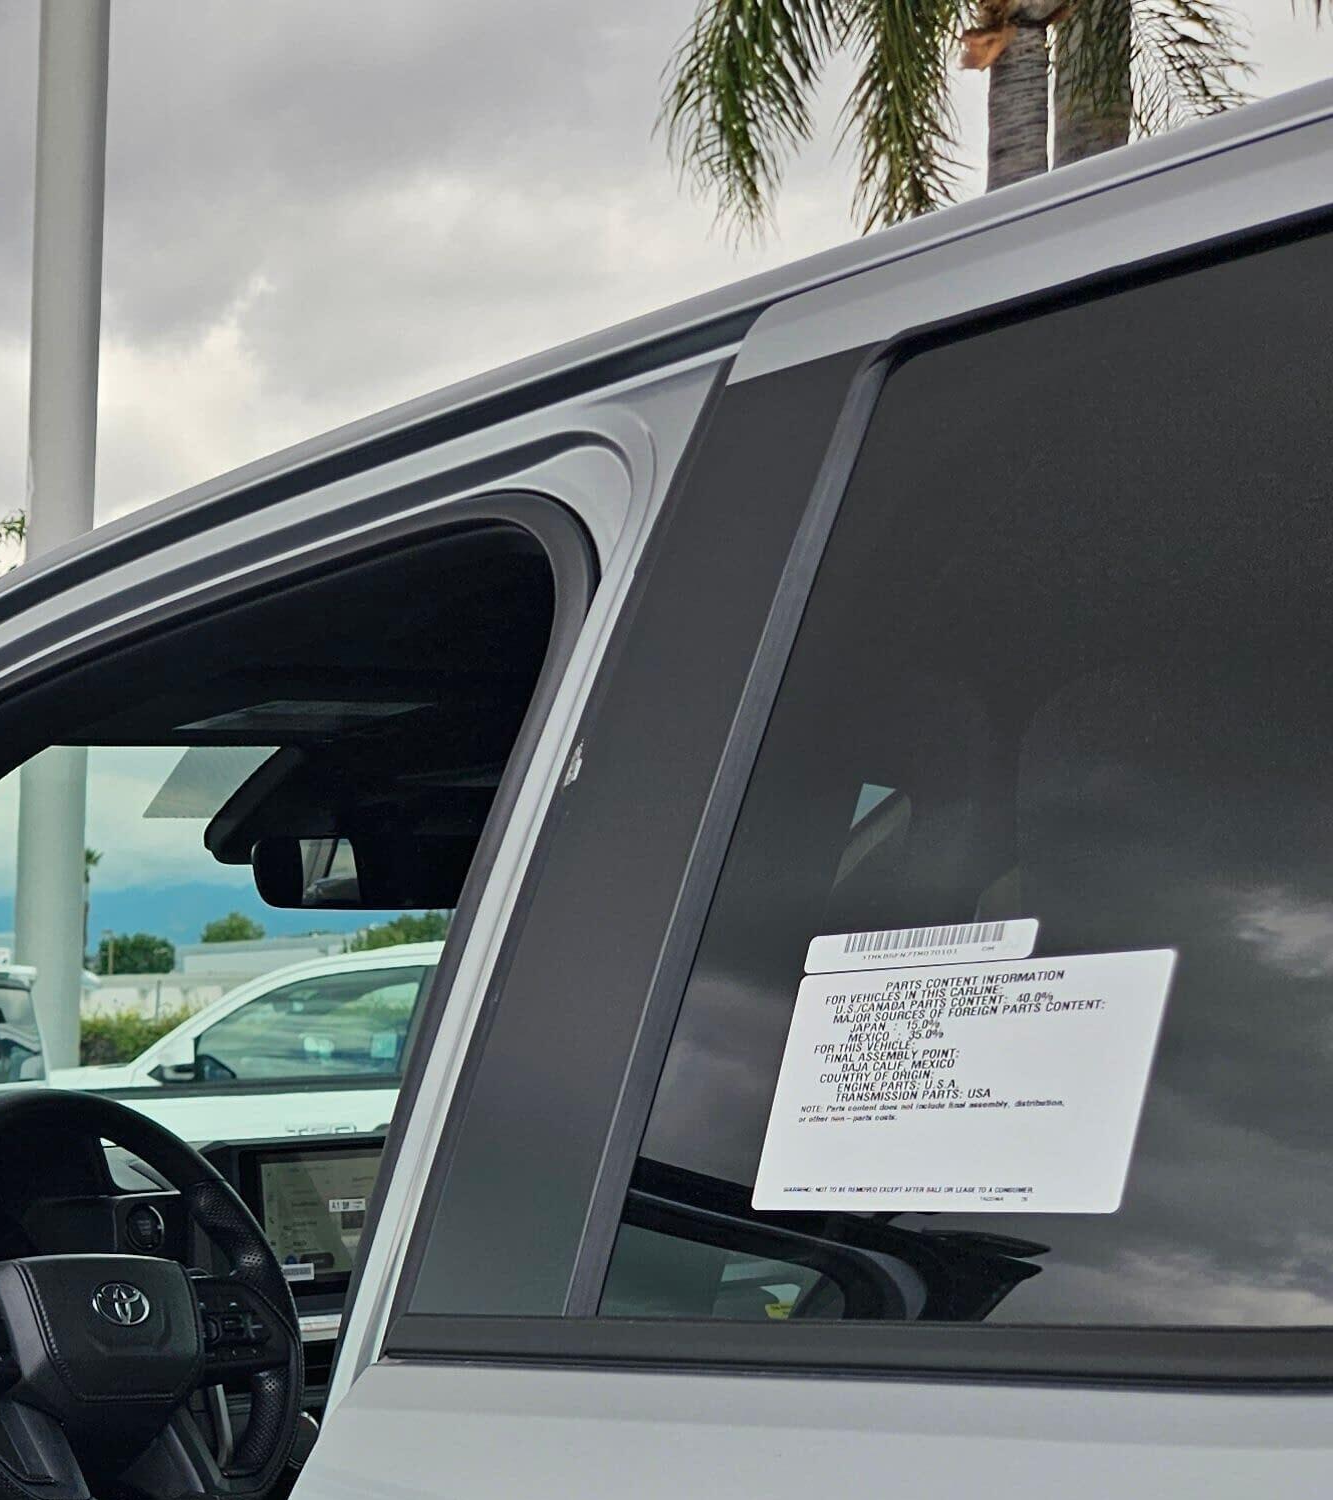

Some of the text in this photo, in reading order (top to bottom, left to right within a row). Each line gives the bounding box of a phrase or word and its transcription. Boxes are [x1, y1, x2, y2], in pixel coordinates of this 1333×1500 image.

[886, 970, 1065, 991] PARTS CONTENT INFORMATION
[826, 994, 846, 1005] FOR
[850, 991, 901, 1004] VEHICLES
[905, 990, 917, 1000] IN
[921, 987, 946, 999] THIS
[910, 998, 946, 1010] PARTS
[951, 995, 1008, 1007] CONTENT:
[1017, 991, 1054, 1003] 40.0%
[833, 999, 1106, 1024] MAJOR SOURCES OF FOREIGN PARTS CONTENT:
[850, 1021, 886, 1033] JAPAN
[907, 1019, 940, 1030] 15.0%
[848, 1031, 889, 1043] MEXICO
[908, 1029, 944, 1041] 35.0%
[814, 1039, 915, 1054] FOR THIS VEHICLE:
[825, 1048, 959, 1064] FINAL ASSEMBLY POINT:
[842, 1062, 868, 1072] BAJA
[911, 1059, 955, 1069] MEXICO
[820, 1070, 934, 1083] COUNTRY OF ORIGIN:
[837, 1082, 876, 1092] ENGINE
[880, 1080, 921, 1091] PARTS:
[836, 1088, 991, 1102] TRANSMISSION PARTS: USA
